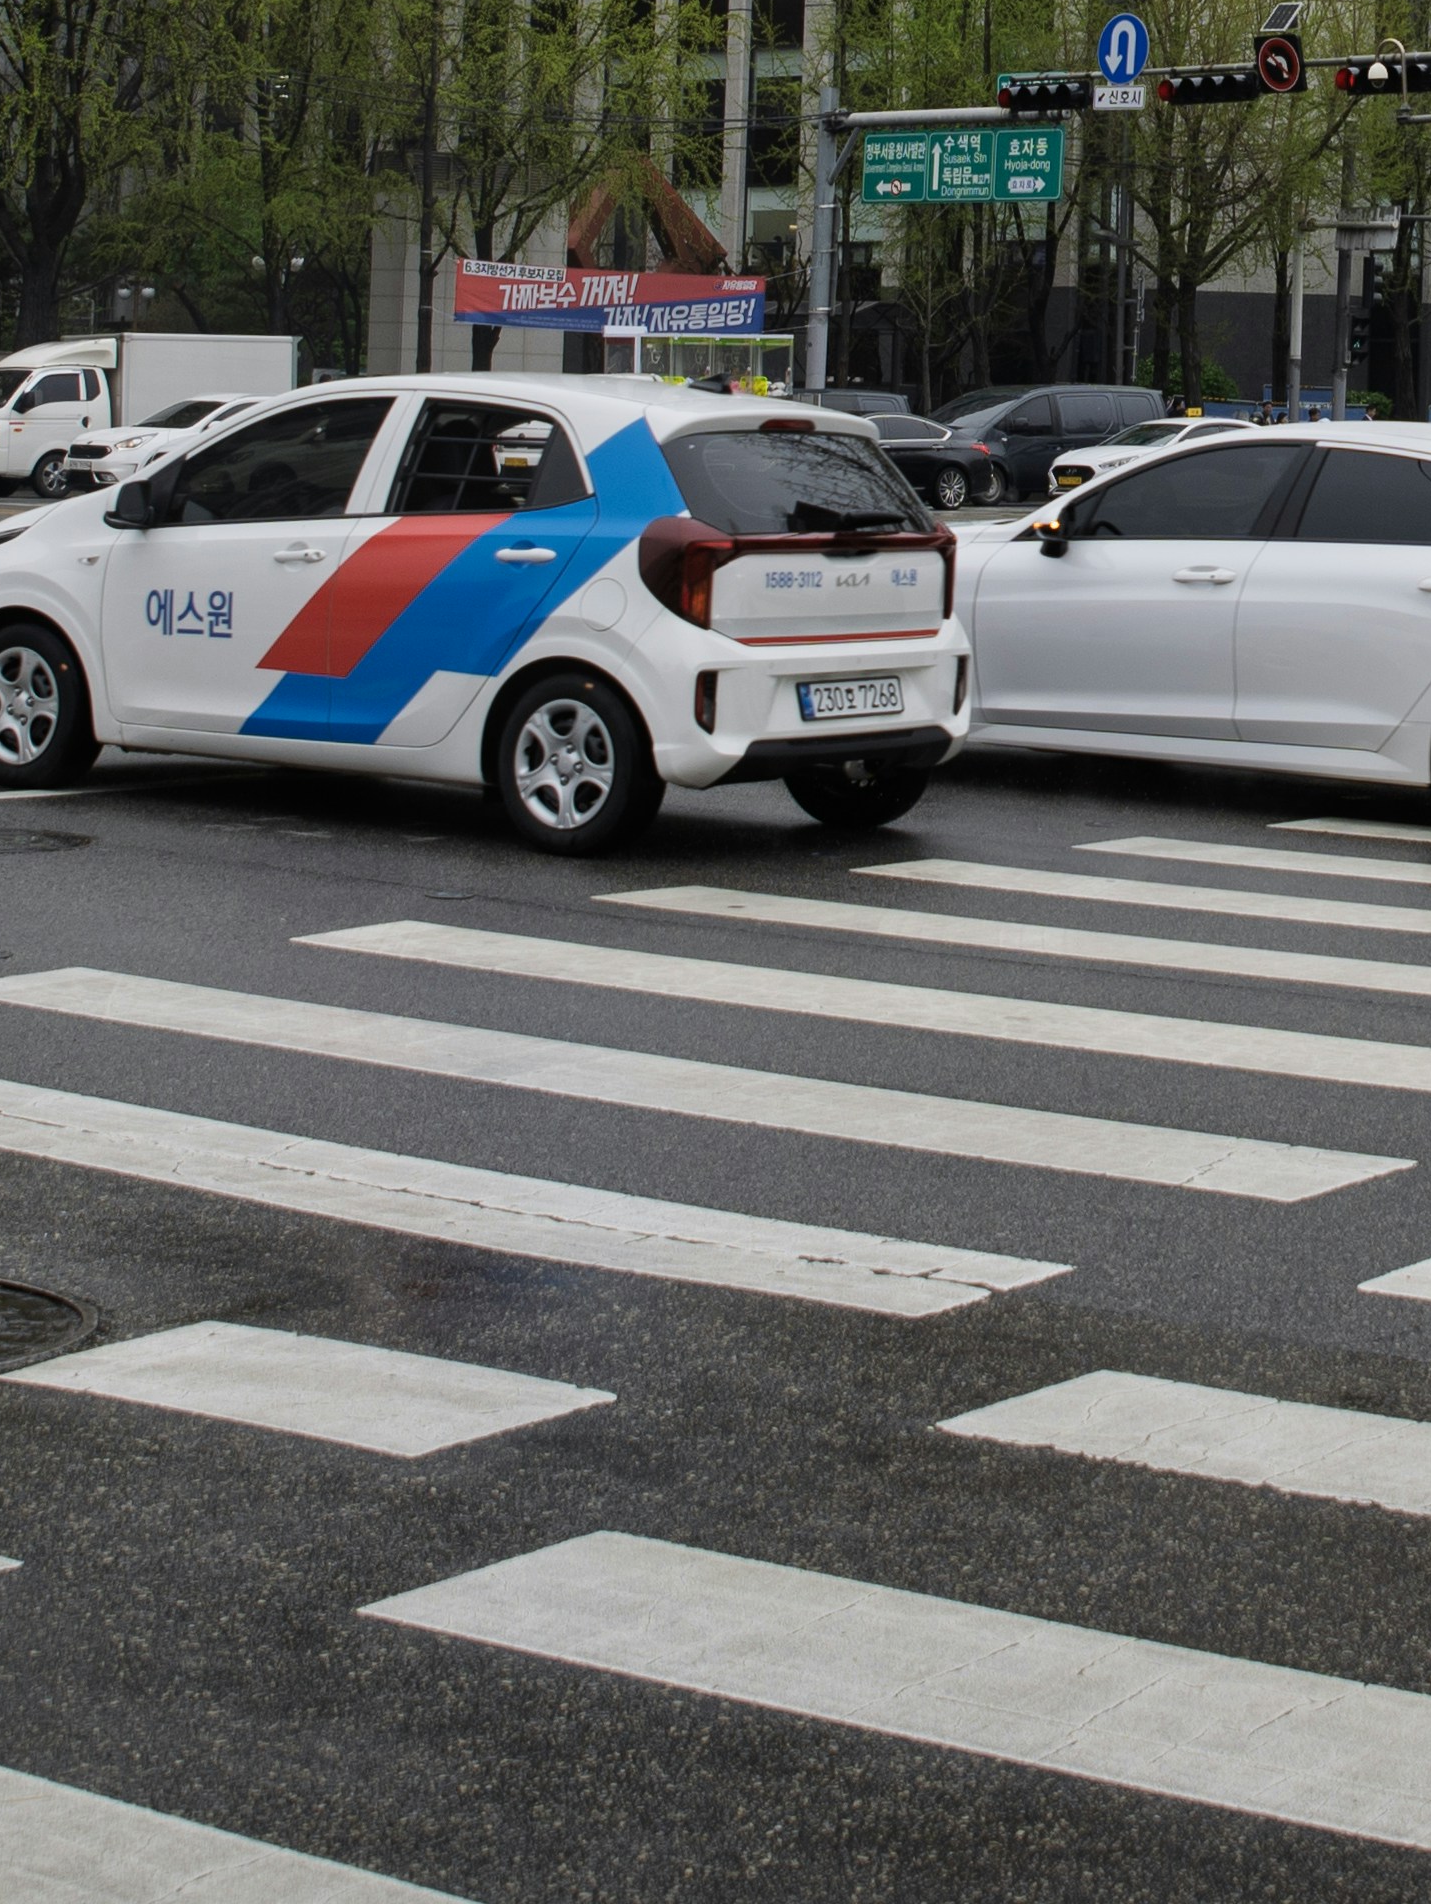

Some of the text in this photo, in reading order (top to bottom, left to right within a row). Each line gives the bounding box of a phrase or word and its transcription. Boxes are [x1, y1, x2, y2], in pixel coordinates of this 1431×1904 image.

[1108, 89, 1142, 106] 신호시
[943, 134, 981, 152] 수색역
[1009, 137, 1049, 157] 효자동
[942, 151, 987, 164] Susaek Stn
[1004, 158, 1051, 173] Hyoja-dong
[942, 166, 972, 185] 독립문
[941, 185, 989, 198] Dongnimmun
[464, 261, 565, 282] 6.3지방선거 후보자 모집
[499, 273, 640, 311] 가짜보수 꺼져!
[604, 304, 650, 327] 가자!
[649, 298, 757, 332] 자유통일당!
[765, 571, 823, 588] 1588-3112
[891, 568, 918, 586] 에스원
[146, 588, 234, 639] 에스원
[813, 682, 899, 713] 230호 7268
